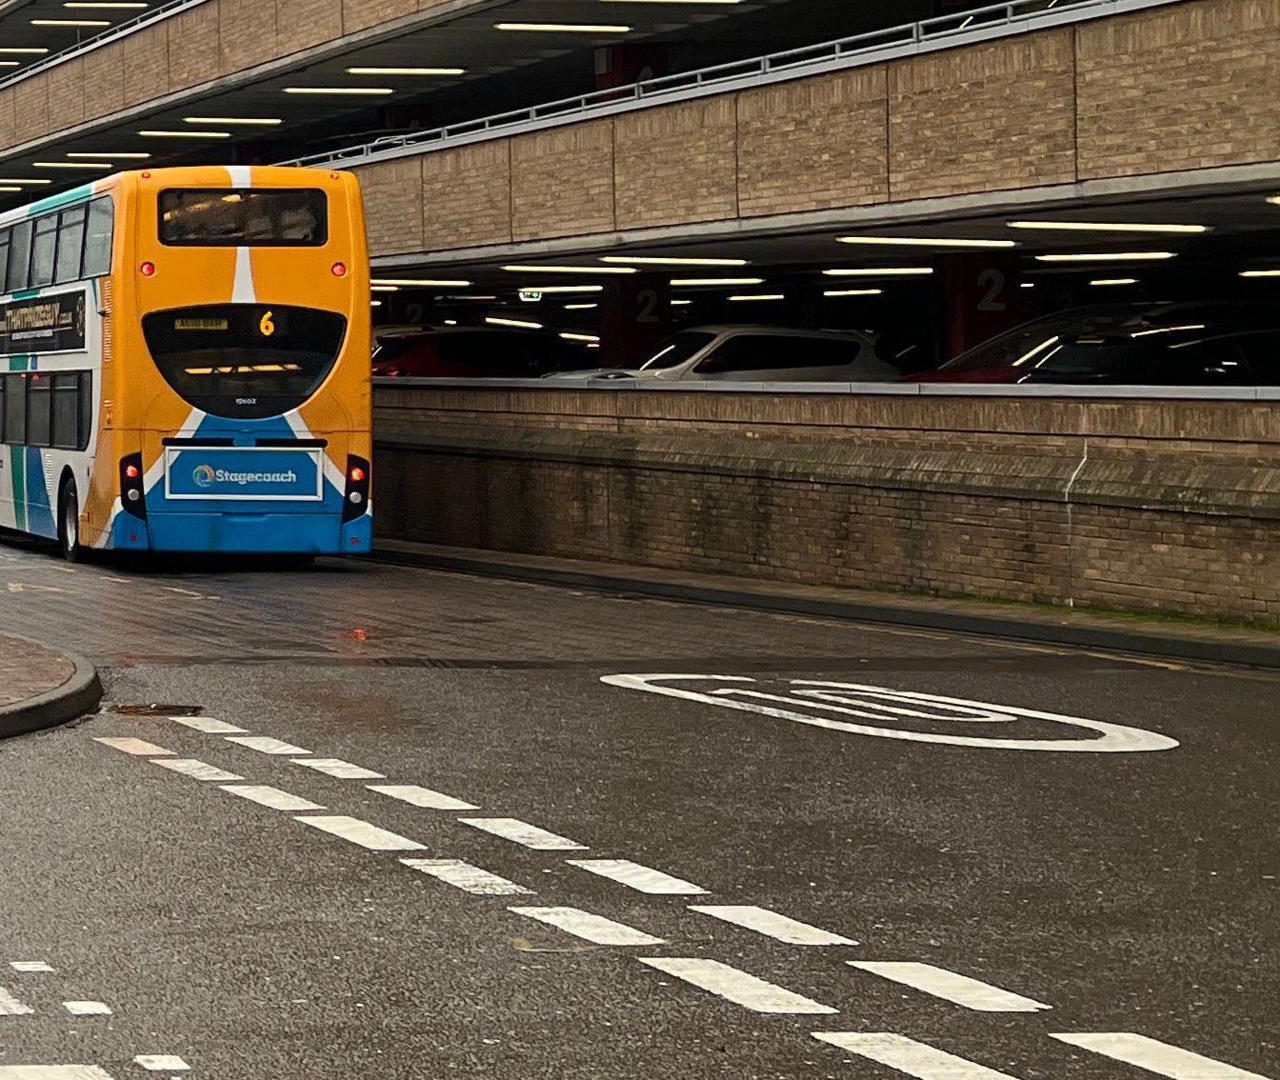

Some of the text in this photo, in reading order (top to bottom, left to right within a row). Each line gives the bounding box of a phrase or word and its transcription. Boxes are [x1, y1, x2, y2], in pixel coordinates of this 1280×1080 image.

[977, 269, 1007, 312] 2
[636, 290, 660, 323] 2
[260, 310, 274, 336] 6
[215, 469, 297, 485] Stagecoach
